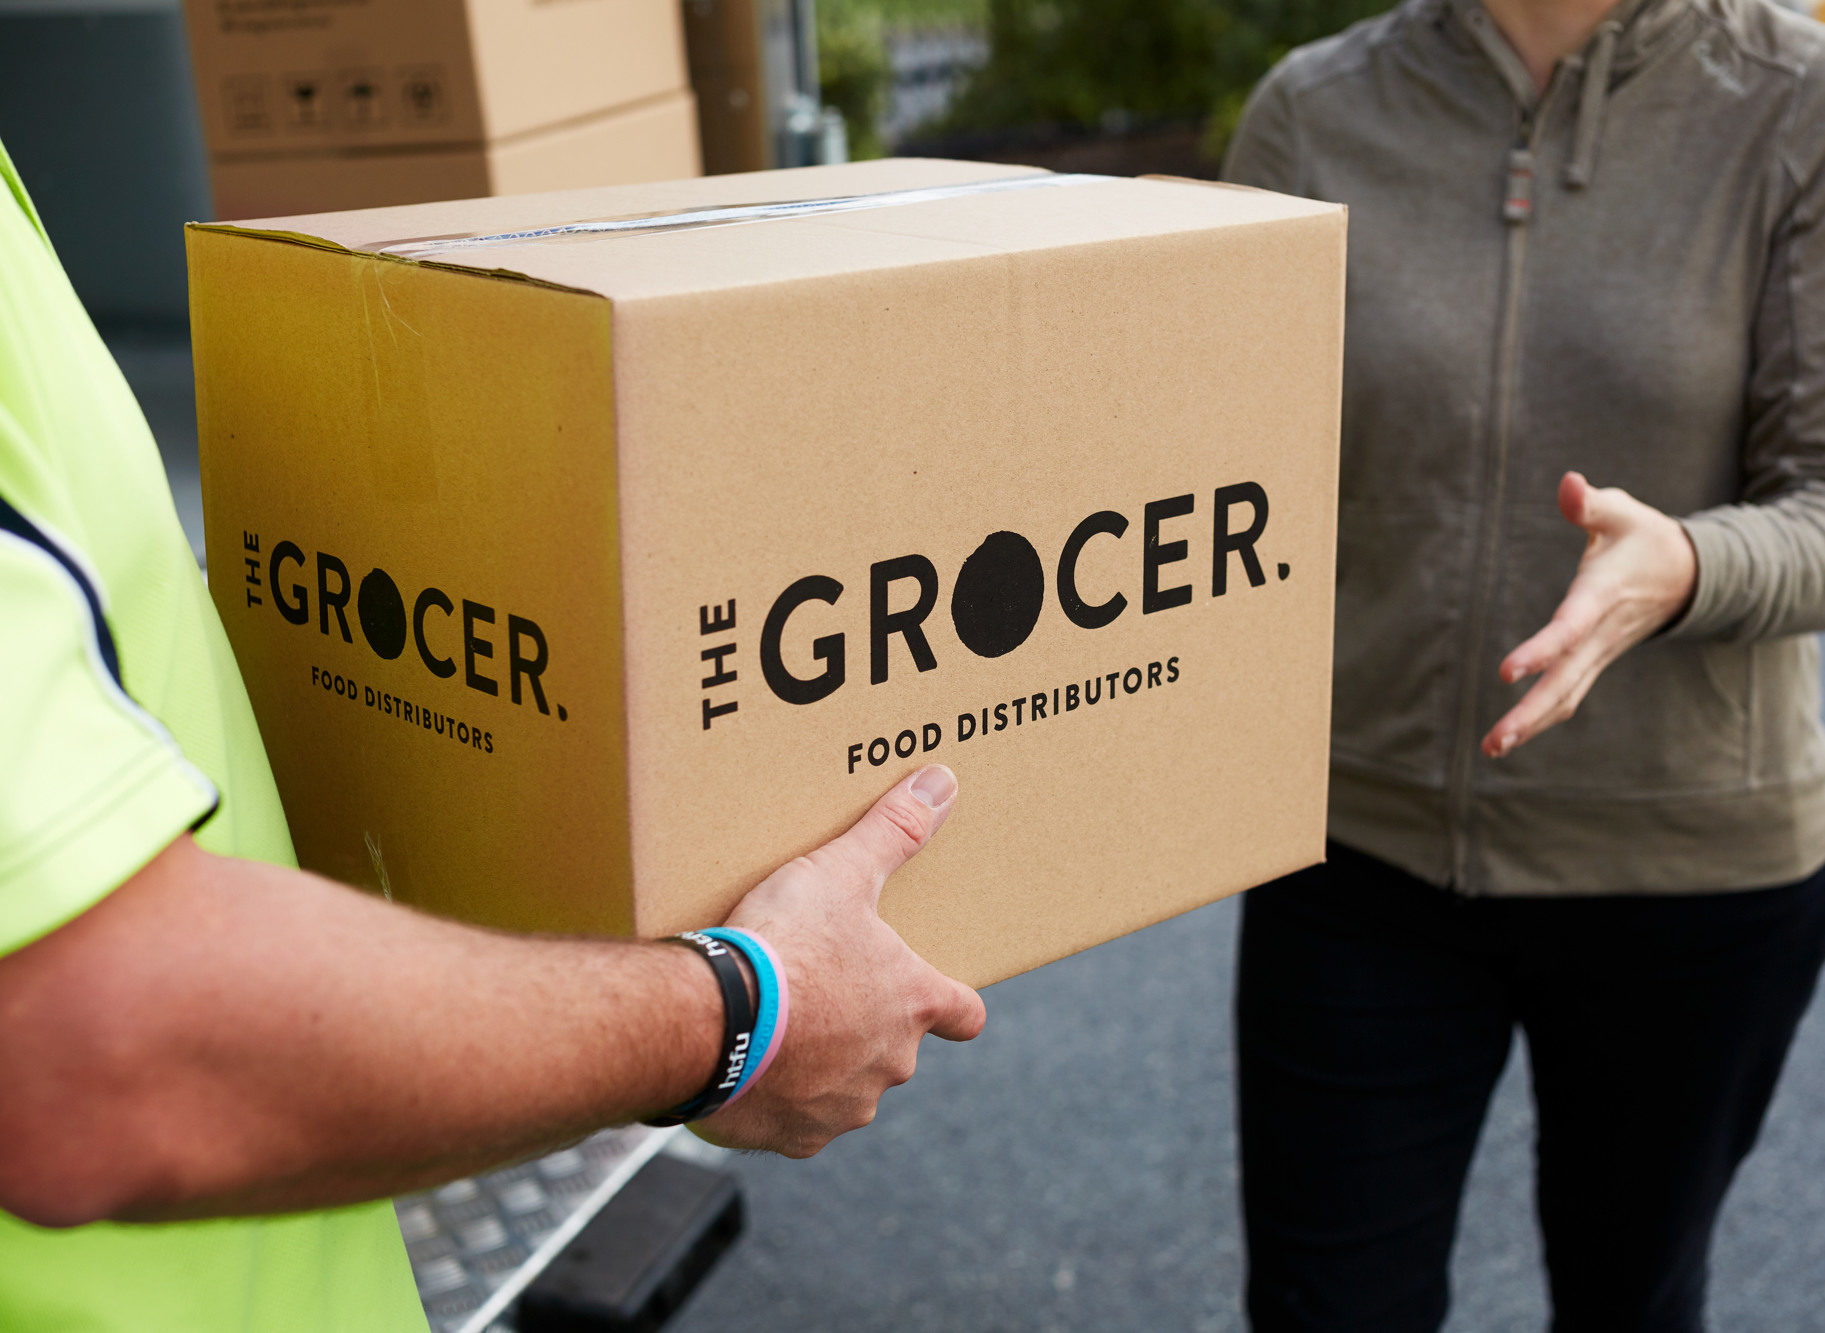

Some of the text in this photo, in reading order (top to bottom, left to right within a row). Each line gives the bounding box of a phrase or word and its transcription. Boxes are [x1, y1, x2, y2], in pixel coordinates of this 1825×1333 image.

[243, 529, 569, 722] THE GROCER.
[699, 480, 1291, 731] THE GROCER.
[311, 665, 494, 754] FOOD DISTRIBUTORS
[847, 656, 1180, 775] FOOD DISTRIBUTORS
[717, 1031, 750, 1089] htfu
